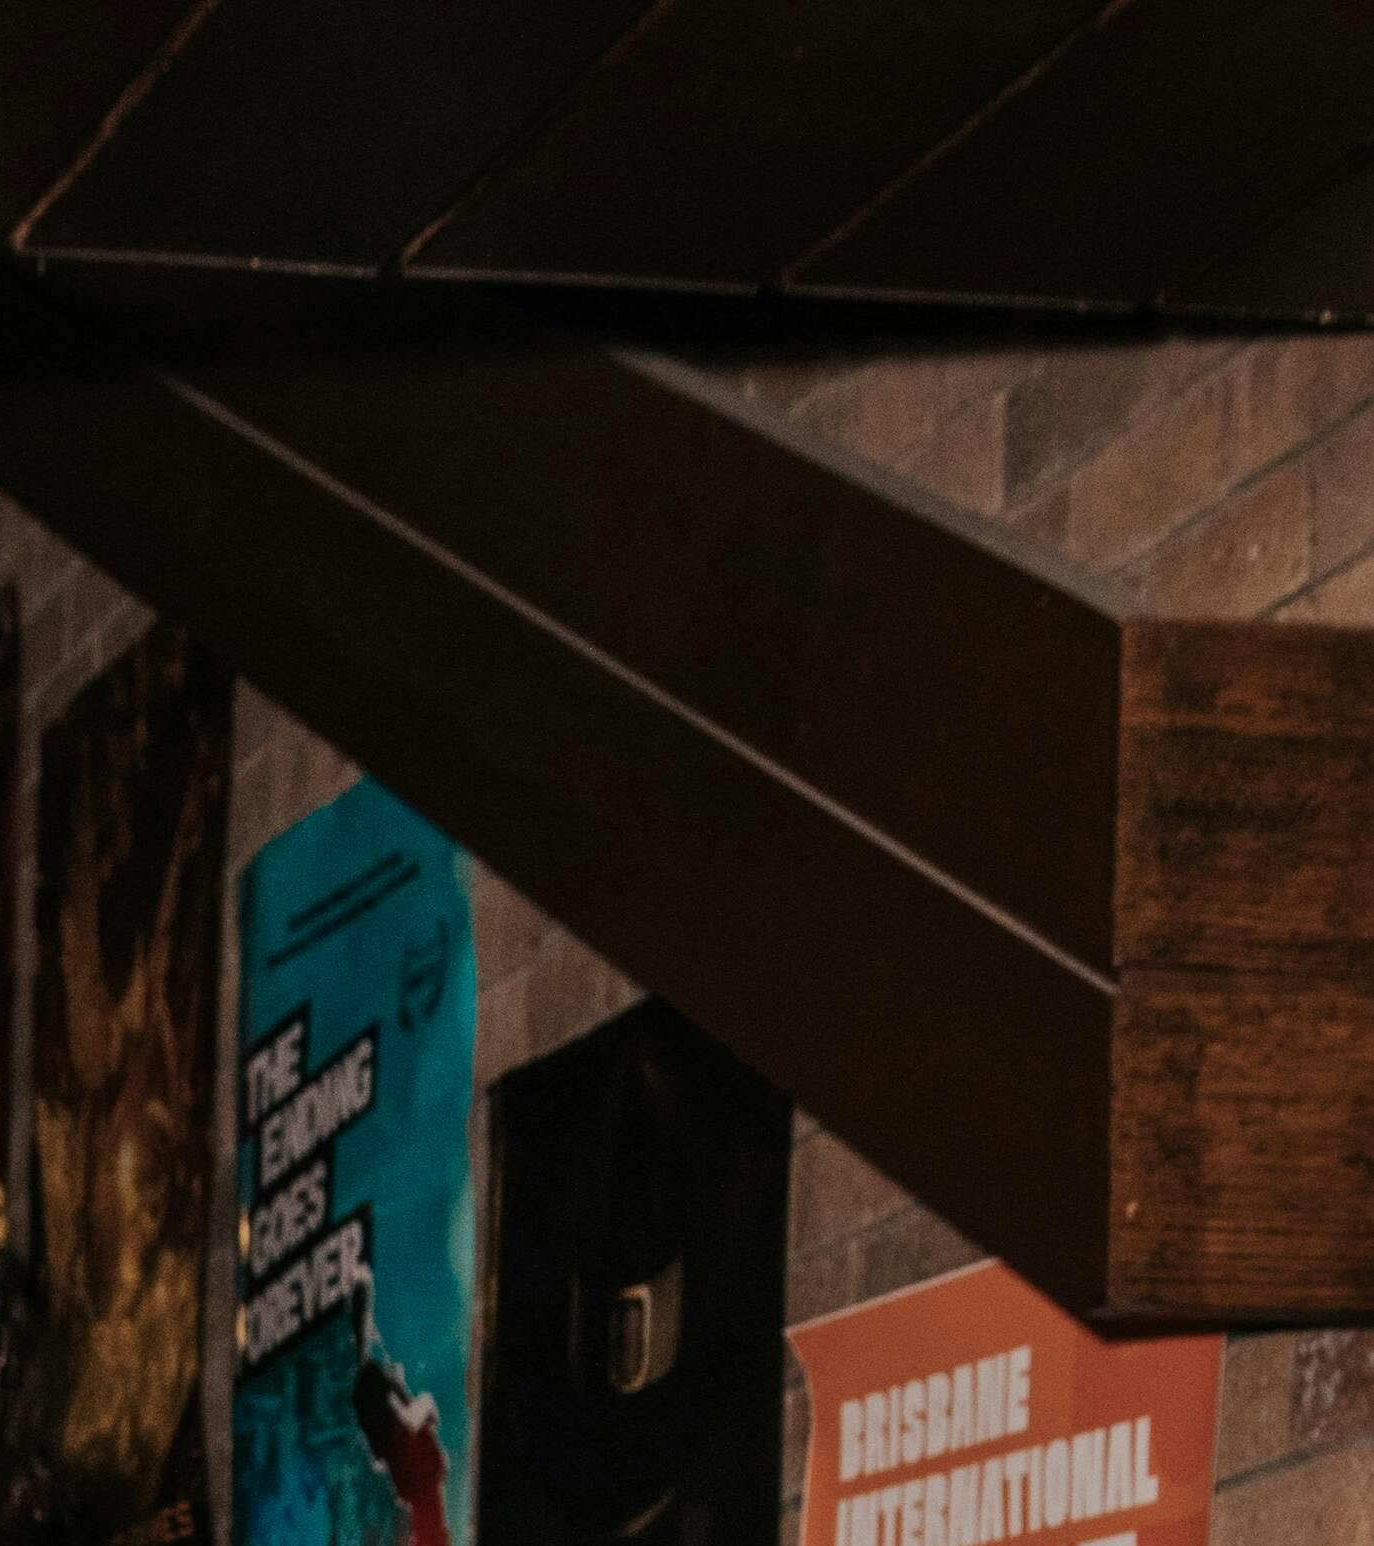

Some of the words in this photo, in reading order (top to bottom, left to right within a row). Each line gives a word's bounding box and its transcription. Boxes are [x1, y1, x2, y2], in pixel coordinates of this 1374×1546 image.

[246, 1021, 304, 1123] THE
[260, 1037, 373, 1186] ENDING
[251, 1157, 327, 1278] GOES
[839, 1345, 1032, 1483] BRISBANE
